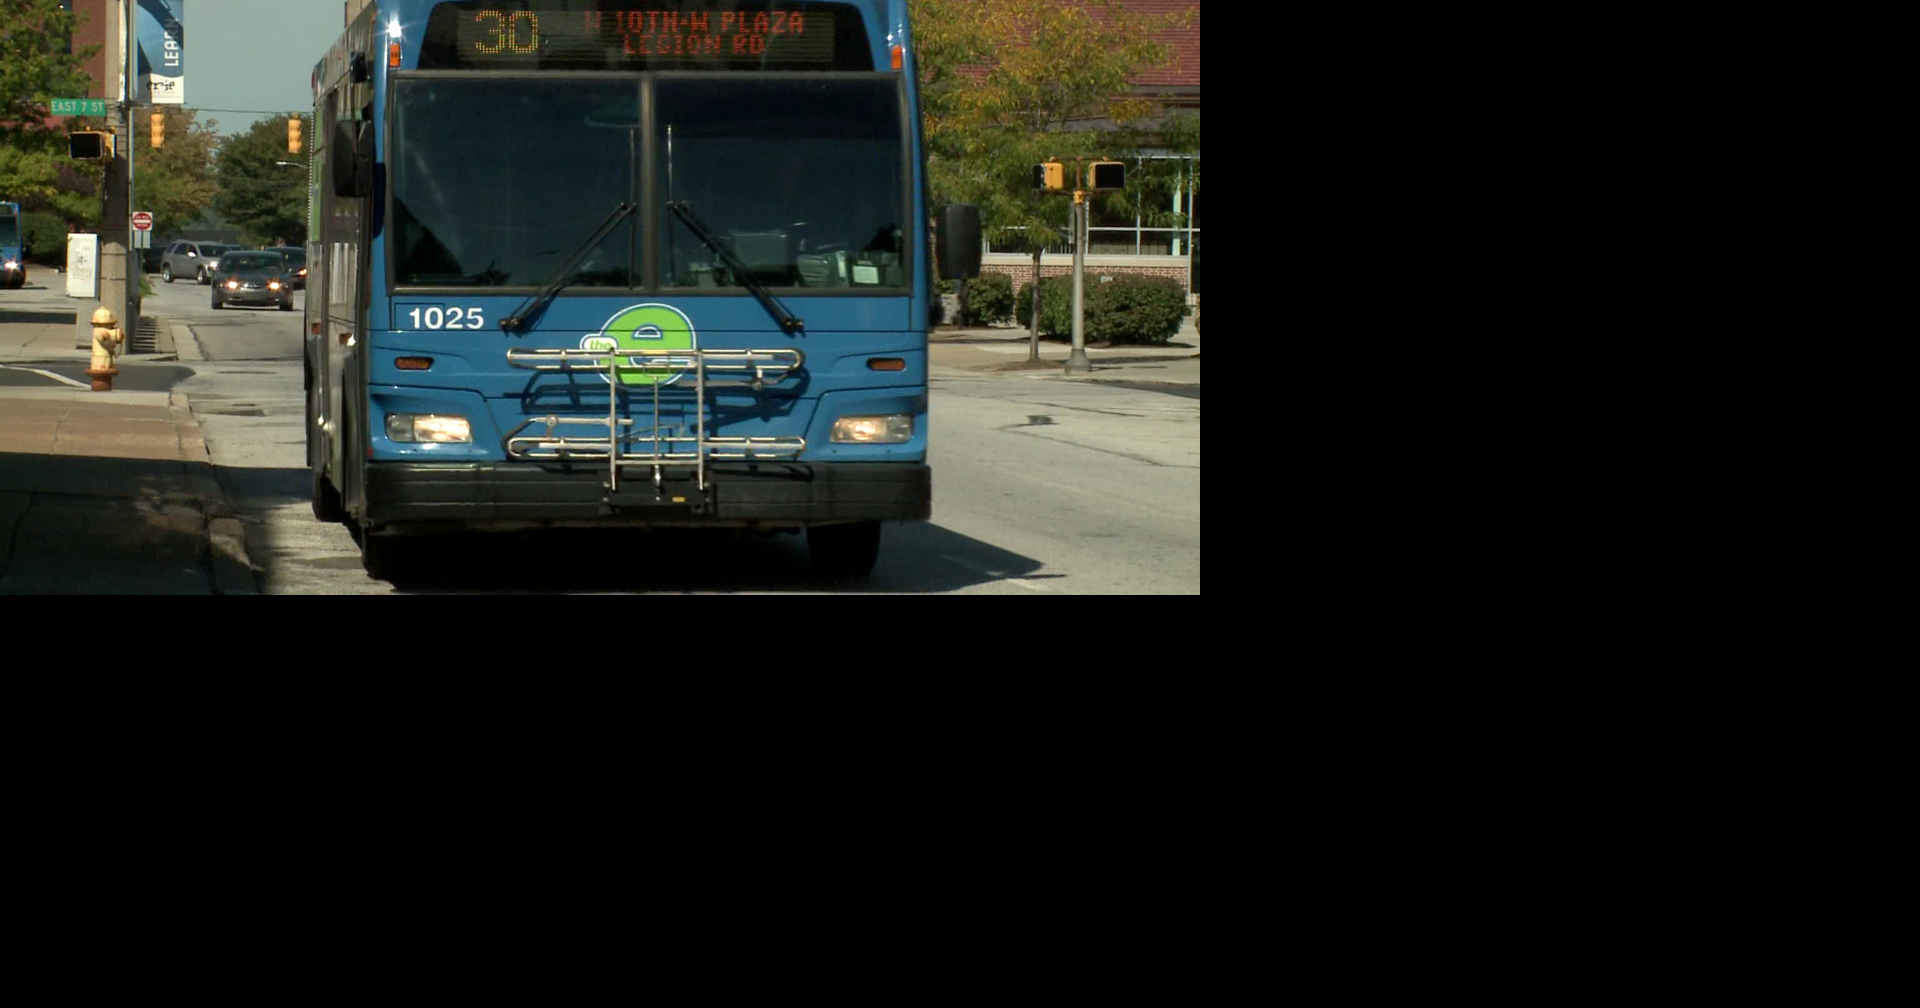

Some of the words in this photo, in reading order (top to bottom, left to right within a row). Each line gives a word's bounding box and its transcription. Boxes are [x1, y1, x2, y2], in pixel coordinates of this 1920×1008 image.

[475, 9, 539, 54] 30
[720, 10, 804, 33] PLAZA
[623, 34, 721, 55] LEGION
[731, 34, 766, 55] RD
[51, 100, 77, 113] EAST
[80, 100, 88, 113] 7
[91, 100, 104, 113] ST
[409, 306, 485, 330] 1025
[588, 338, 613, 351] the
